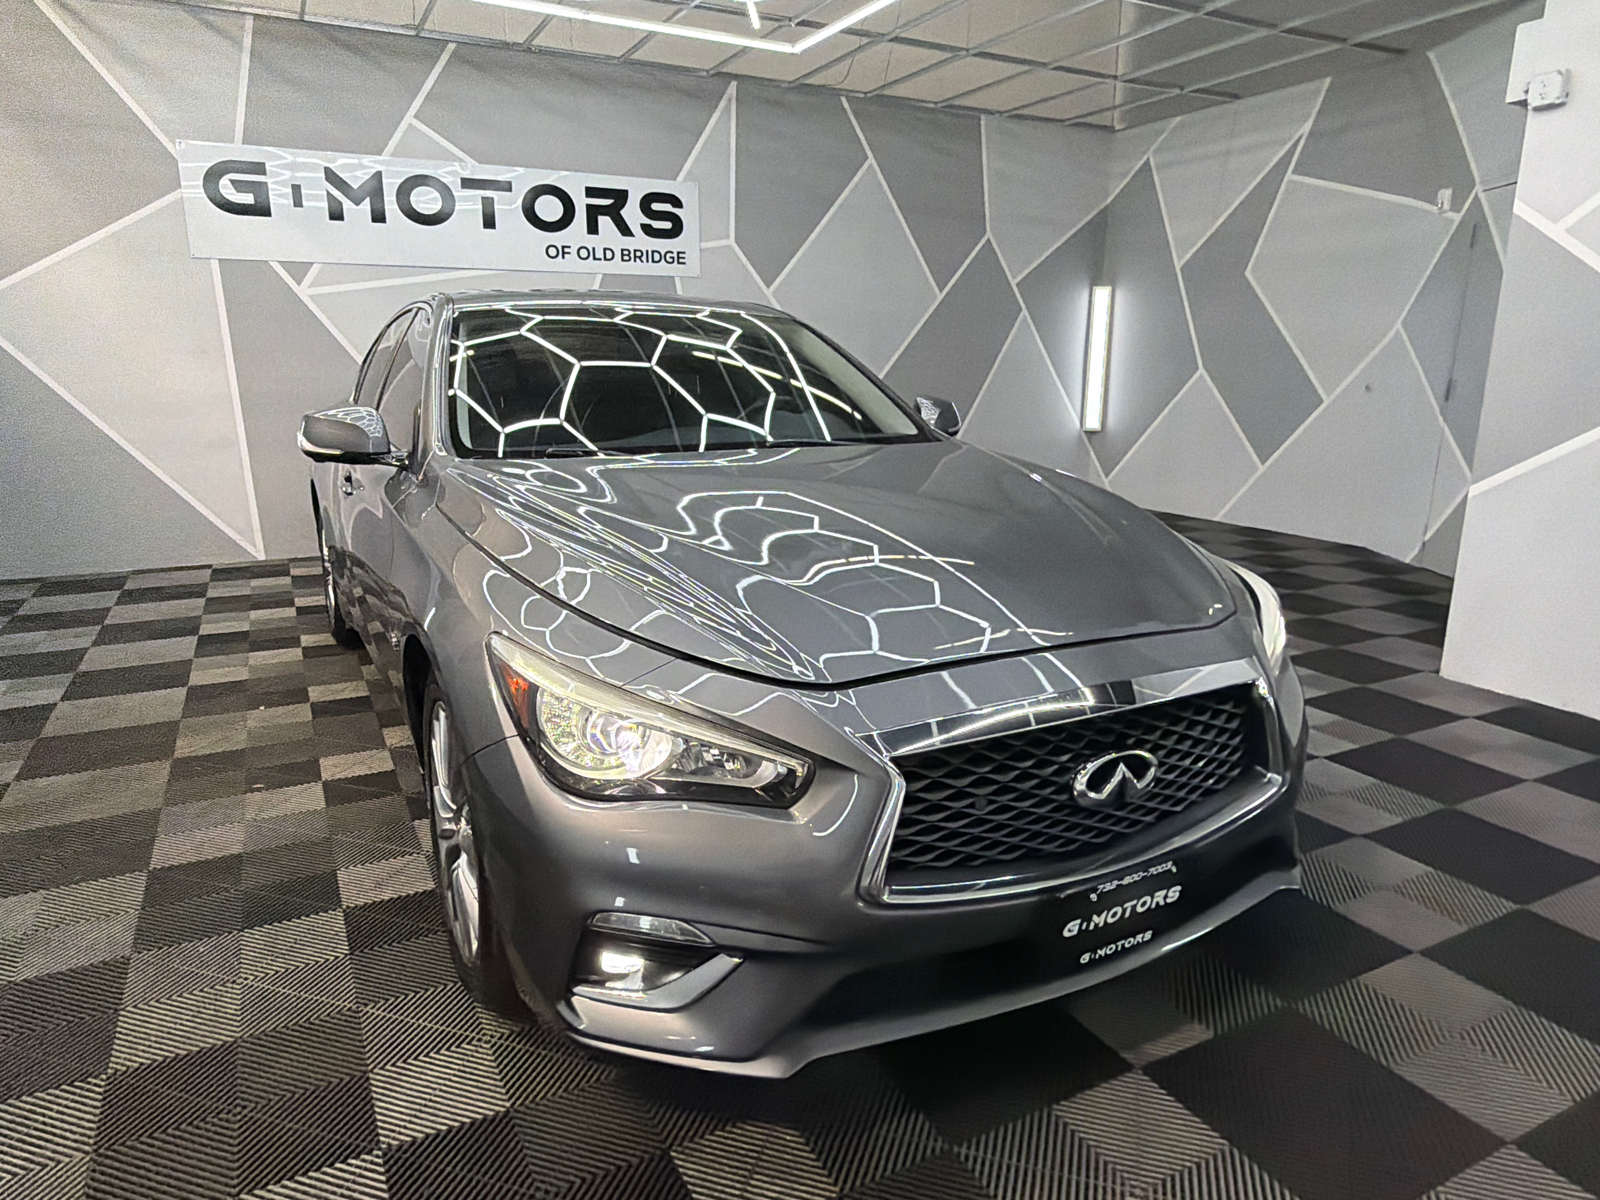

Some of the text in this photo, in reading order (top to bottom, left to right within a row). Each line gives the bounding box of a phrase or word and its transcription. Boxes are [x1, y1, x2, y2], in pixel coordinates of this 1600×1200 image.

[545, 244, 687, 265] OF OLD BRIDGE
